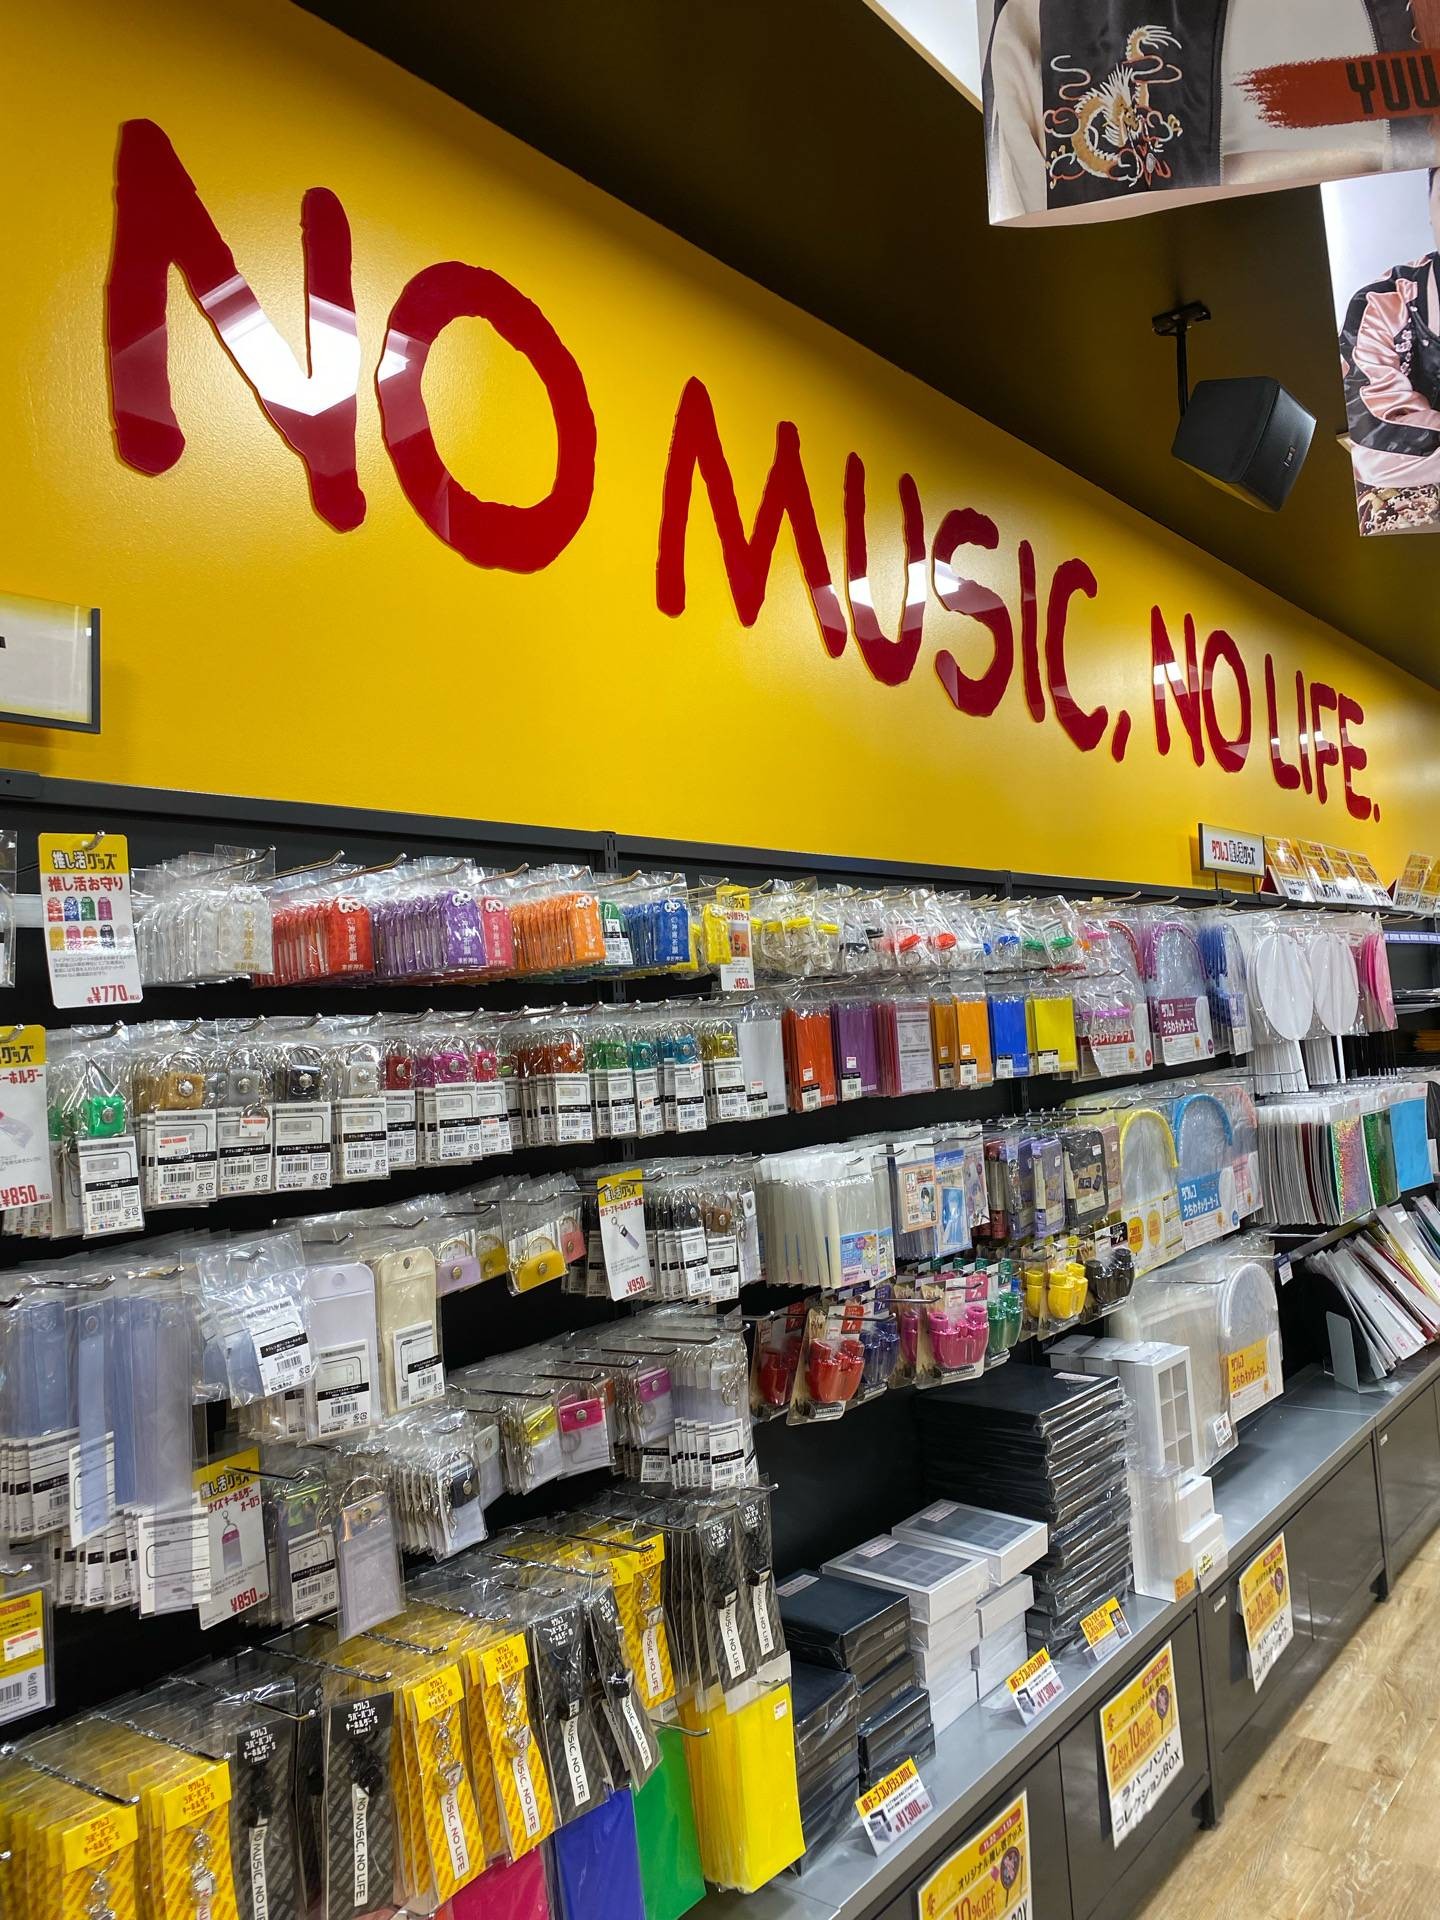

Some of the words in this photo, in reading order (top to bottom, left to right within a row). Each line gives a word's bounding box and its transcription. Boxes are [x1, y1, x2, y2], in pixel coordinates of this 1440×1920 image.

[1346, 55, 1440, 114] YUU
[106, 118, 597, 574] NO
[655, 375, 1131, 763] MUSIC,
[1150, 604, 1252, 775] NO
[1263, 653, 1382, 822] LIFE.
[52, 850, 118, 870] 推し活グッズ
[48, 876, 123, 892] 推し活お守り
[91, 984, 128, 1003] ¥770
[241, 1496, 261, 1513] オーロラ
[231, 1587, 258, 1613] ¥850
[729, 1639, 737, 1653] NO
[731, 1653, 741, 1672] LIFE
[347, 1707, 376, 1722] ラバーバンド
[353, 1700, 369, 1711] タワレコ
[250, 1727, 267, 1739] タワレコ
[345, 1717, 373, 1731] キーホルダー
[244, 1734, 273, 1750] ラバーバンド
[243, 1745, 271, 1760] キーホルダー
[572, 1758, 581, 1774] NO
[1121, 1736, 1172, 1803] ラバーバンド
[523, 1788, 533, 1805] NO
[575, 1775, 586, 1800] LIFE
[356, 1797, 367, 1811] NO
[527, 1806, 537, 1831] LIFE
[451, 1827, 461, 1846] NO
[356, 1853, 366, 1872] NO
[453, 1846, 465, 1872] LIFE
[255, 1885, 265, 1905] NO
[356, 1874, 366, 1897] LIFE
